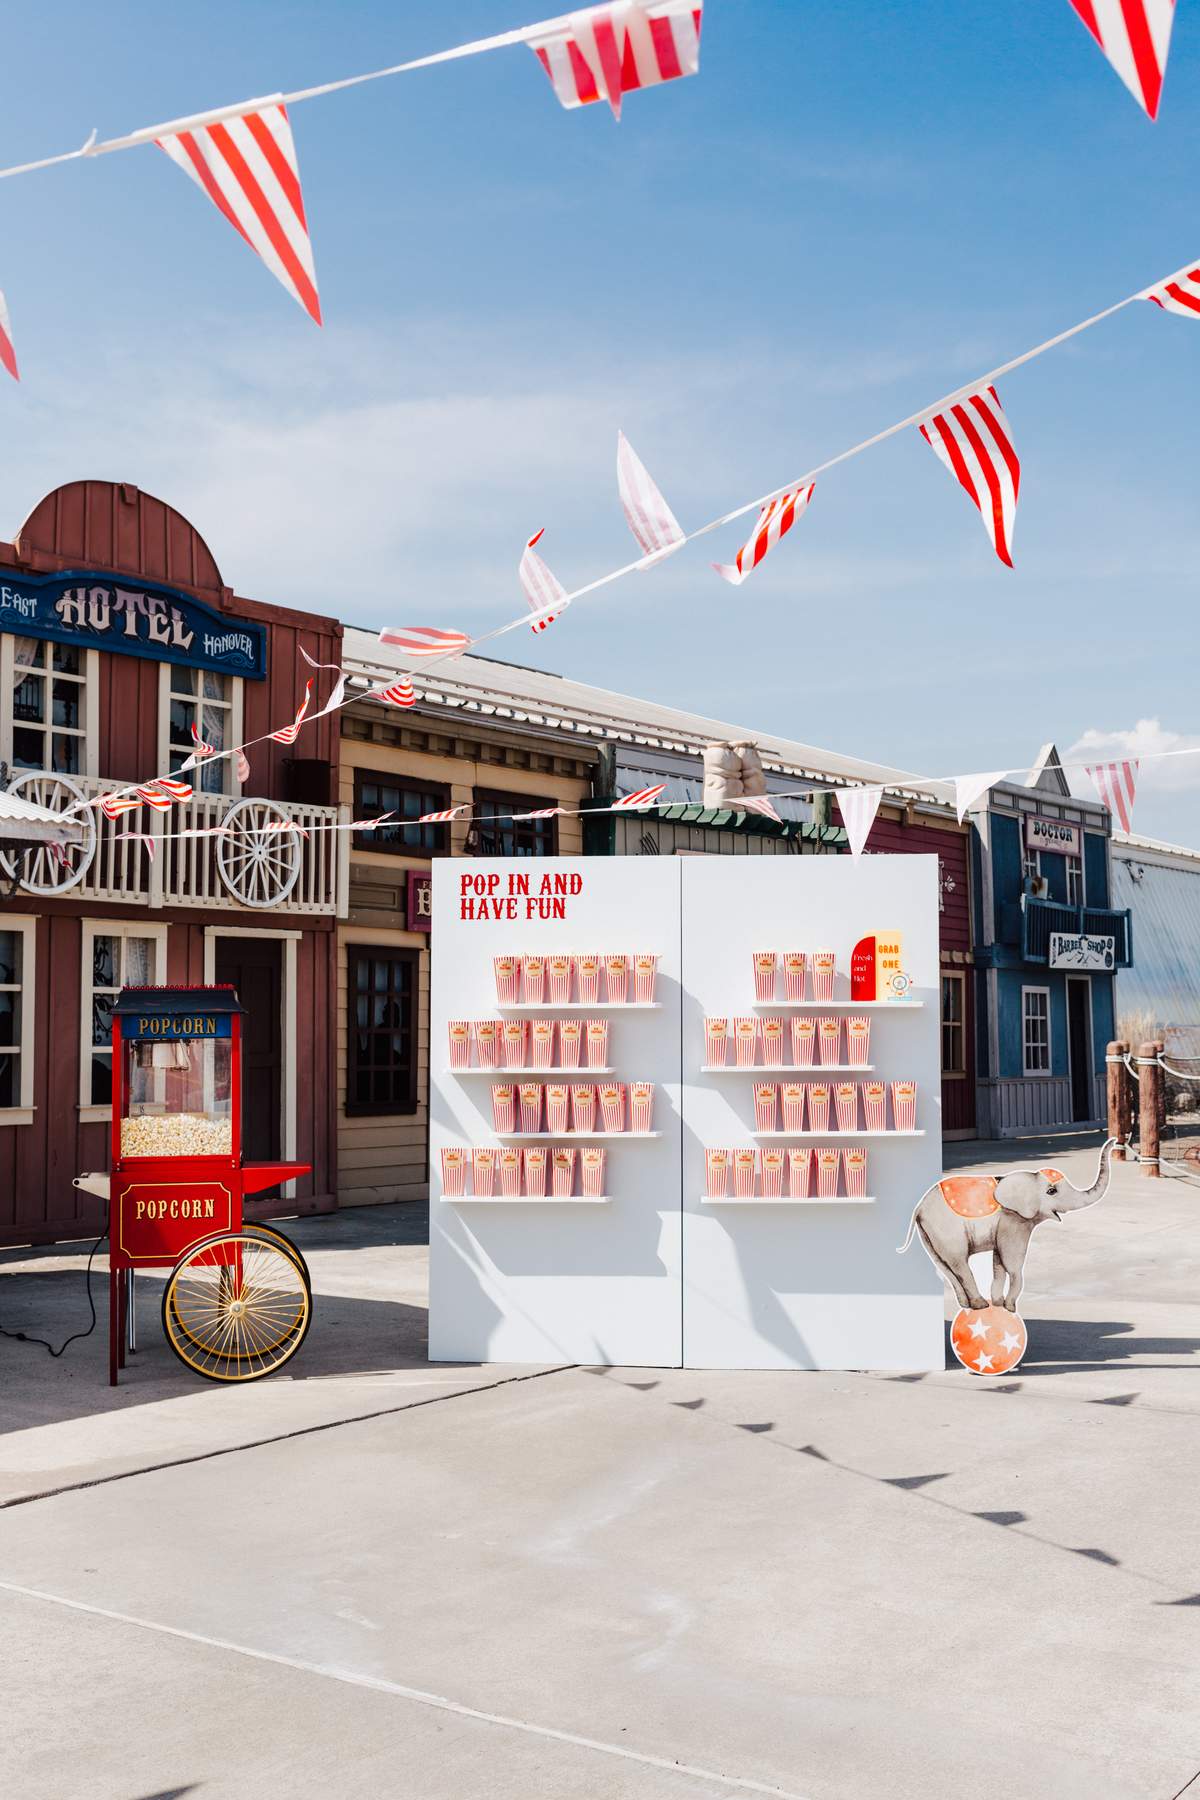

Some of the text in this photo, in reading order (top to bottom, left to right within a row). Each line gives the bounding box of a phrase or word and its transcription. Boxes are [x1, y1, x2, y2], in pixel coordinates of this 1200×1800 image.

[1, 586, 254, 660] EAST HOTEL HANOVER
[1033, 820, 1073, 842] DOCTOR
[460, 873, 583, 896] POP IN AND
[460, 897, 566, 920] HAVE FUN
[878, 944, 899, 954] GRAB
[1057, 936, 1106, 956] BARBER SHOP
[882, 960, 899, 969] ONE
[138, 1017, 217, 1035] POPCORN
[136, 1199, 215, 1220] POPCORN
